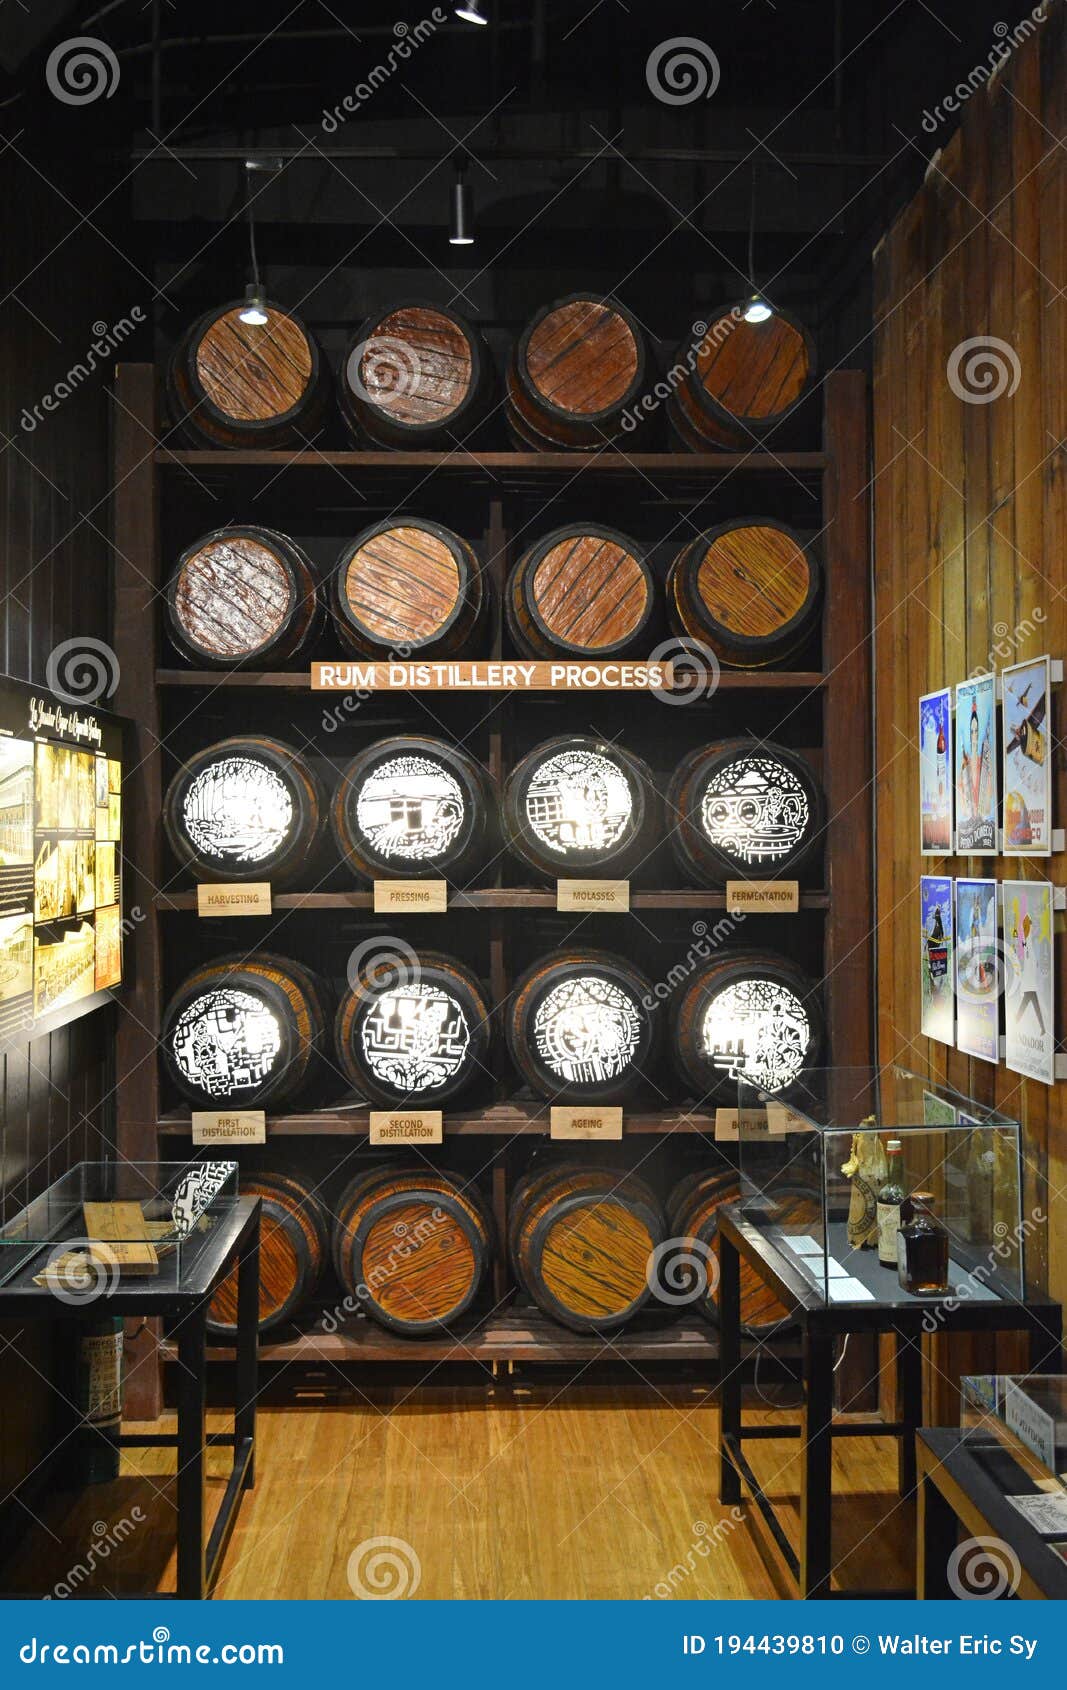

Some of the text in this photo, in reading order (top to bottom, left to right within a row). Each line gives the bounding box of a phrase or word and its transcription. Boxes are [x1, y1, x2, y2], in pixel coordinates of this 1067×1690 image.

[319, 665, 664, 688] RUM DISTILLERY PROCESS
[207, 893, 260, 905] HARVESTING
[389, 892, 430, 903] PRESSING
[572, 890, 616, 902] MOLASSES
[731, 890, 794, 902] FERMENTATION
[217, 1119, 240, 1128] FIRST
[389, 1119, 424, 1129] SECOND
[570, 1119, 603, 1129] AGEING
[201, 1127, 256, 1137] DISTILLATION
[379, 1128, 434, 1138] DISTILLATION
